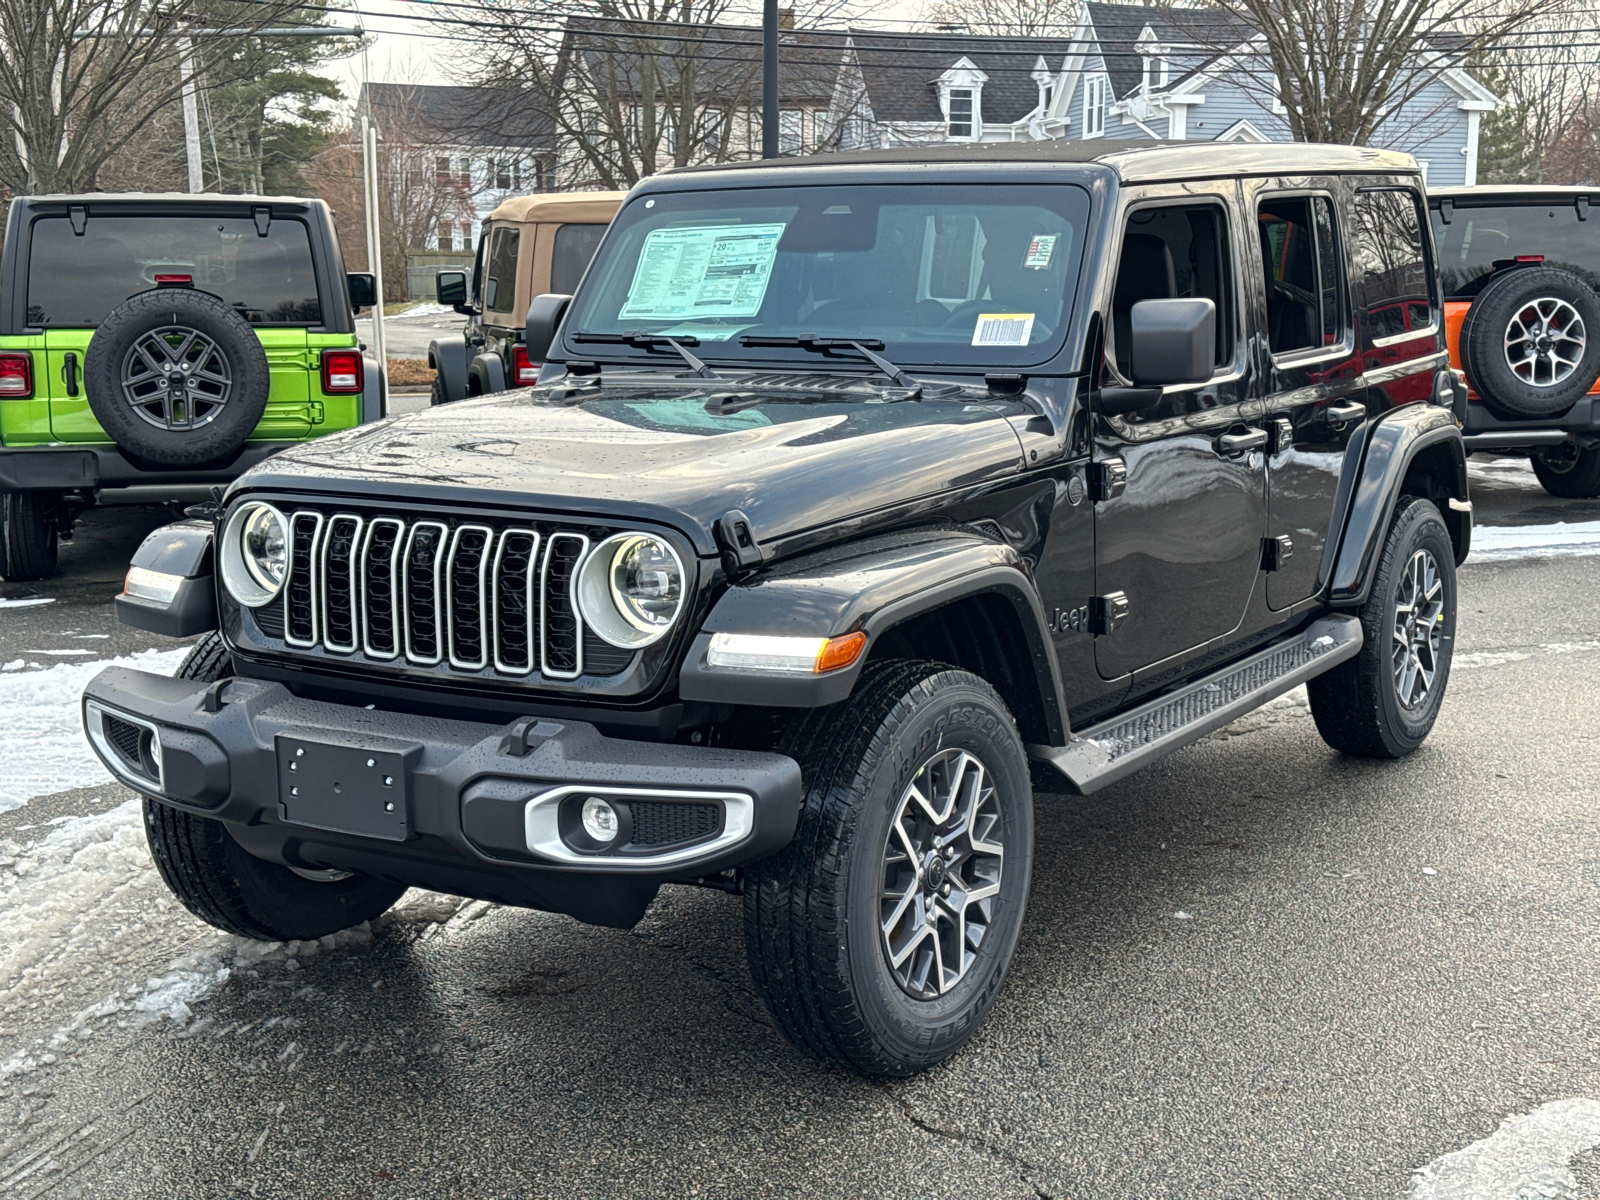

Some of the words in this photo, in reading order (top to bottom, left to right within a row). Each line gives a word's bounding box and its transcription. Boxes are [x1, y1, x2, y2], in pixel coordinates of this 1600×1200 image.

[716, 243, 727, 251] 20
[1048, 605, 1090, 635] Jeep
[901, 962, 1002, 1045] DUELER
